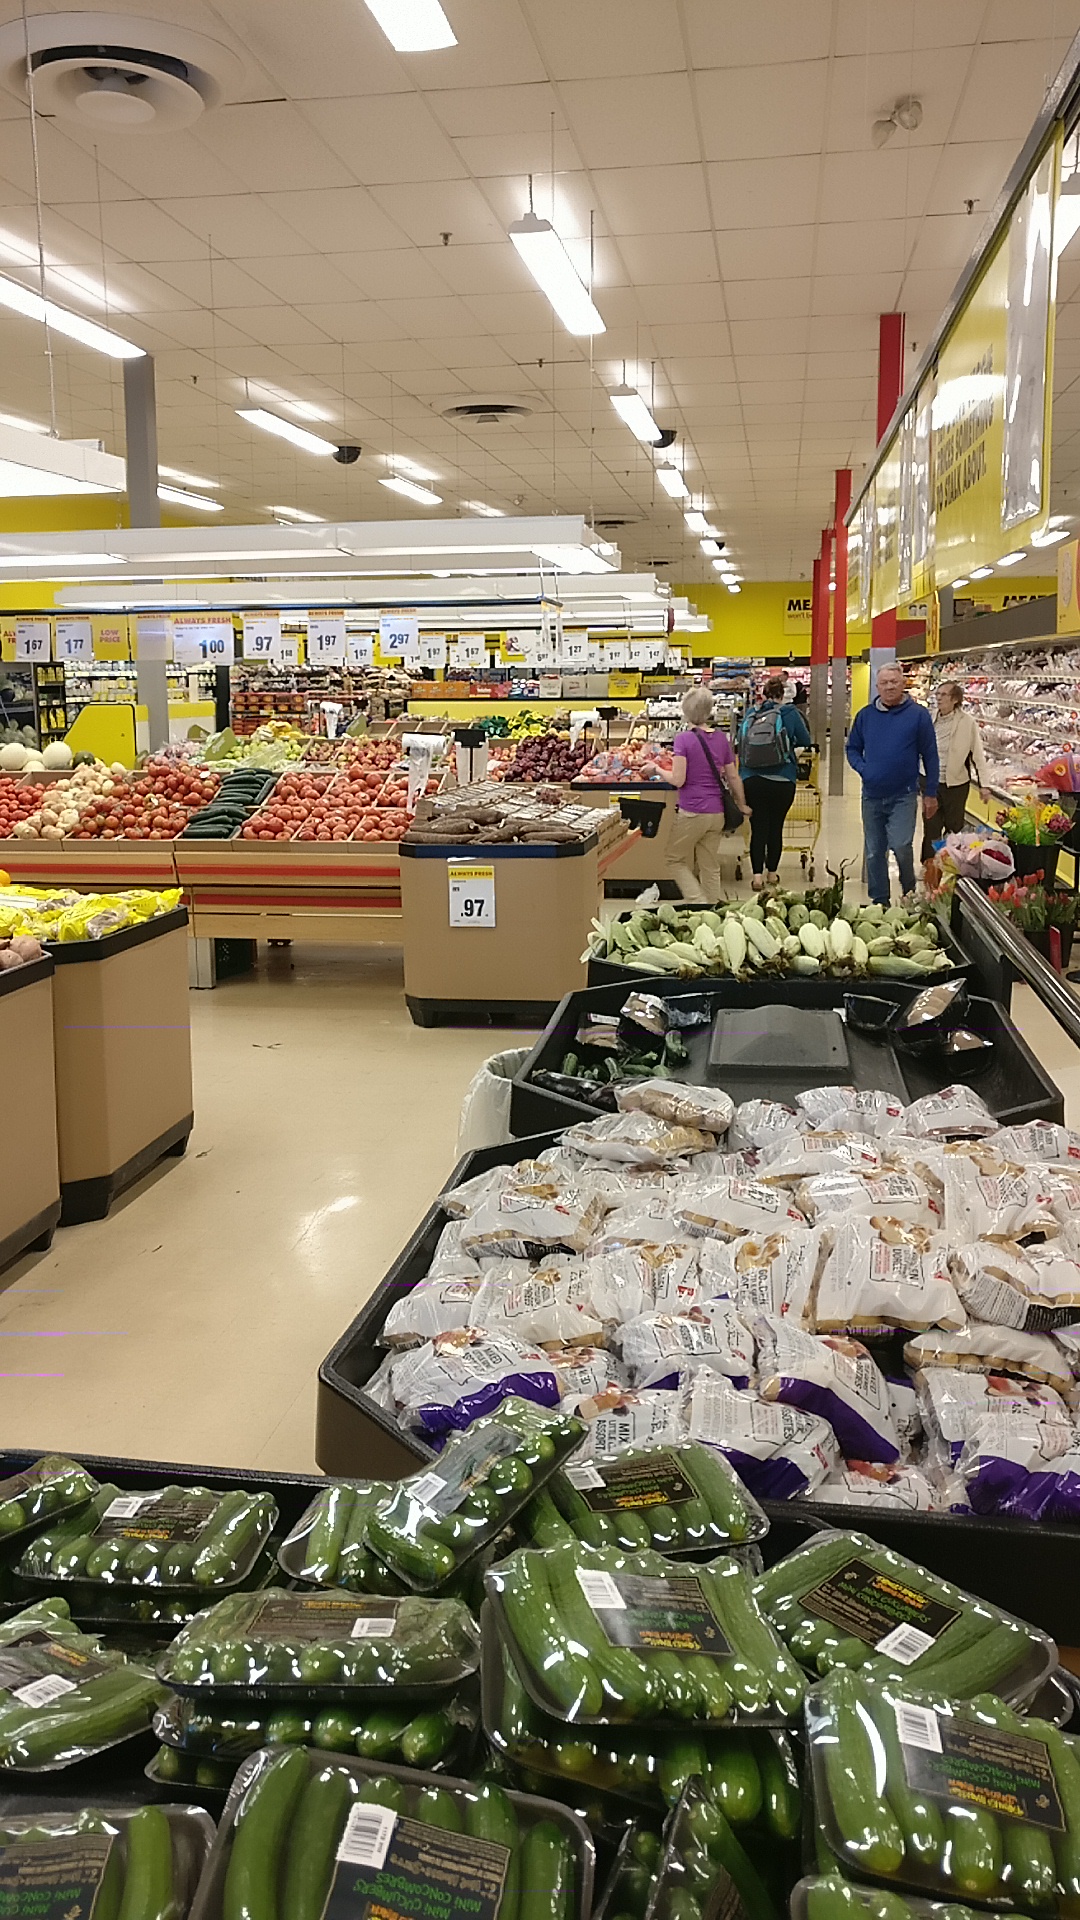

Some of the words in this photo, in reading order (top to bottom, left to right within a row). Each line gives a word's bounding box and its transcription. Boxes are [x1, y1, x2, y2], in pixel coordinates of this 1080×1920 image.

[787, 599, 811, 611] ME
[252, 636, 273, 651] .97
[461, 899, 485, 917] .97
[485, 1346, 502, 1365] MIXED
